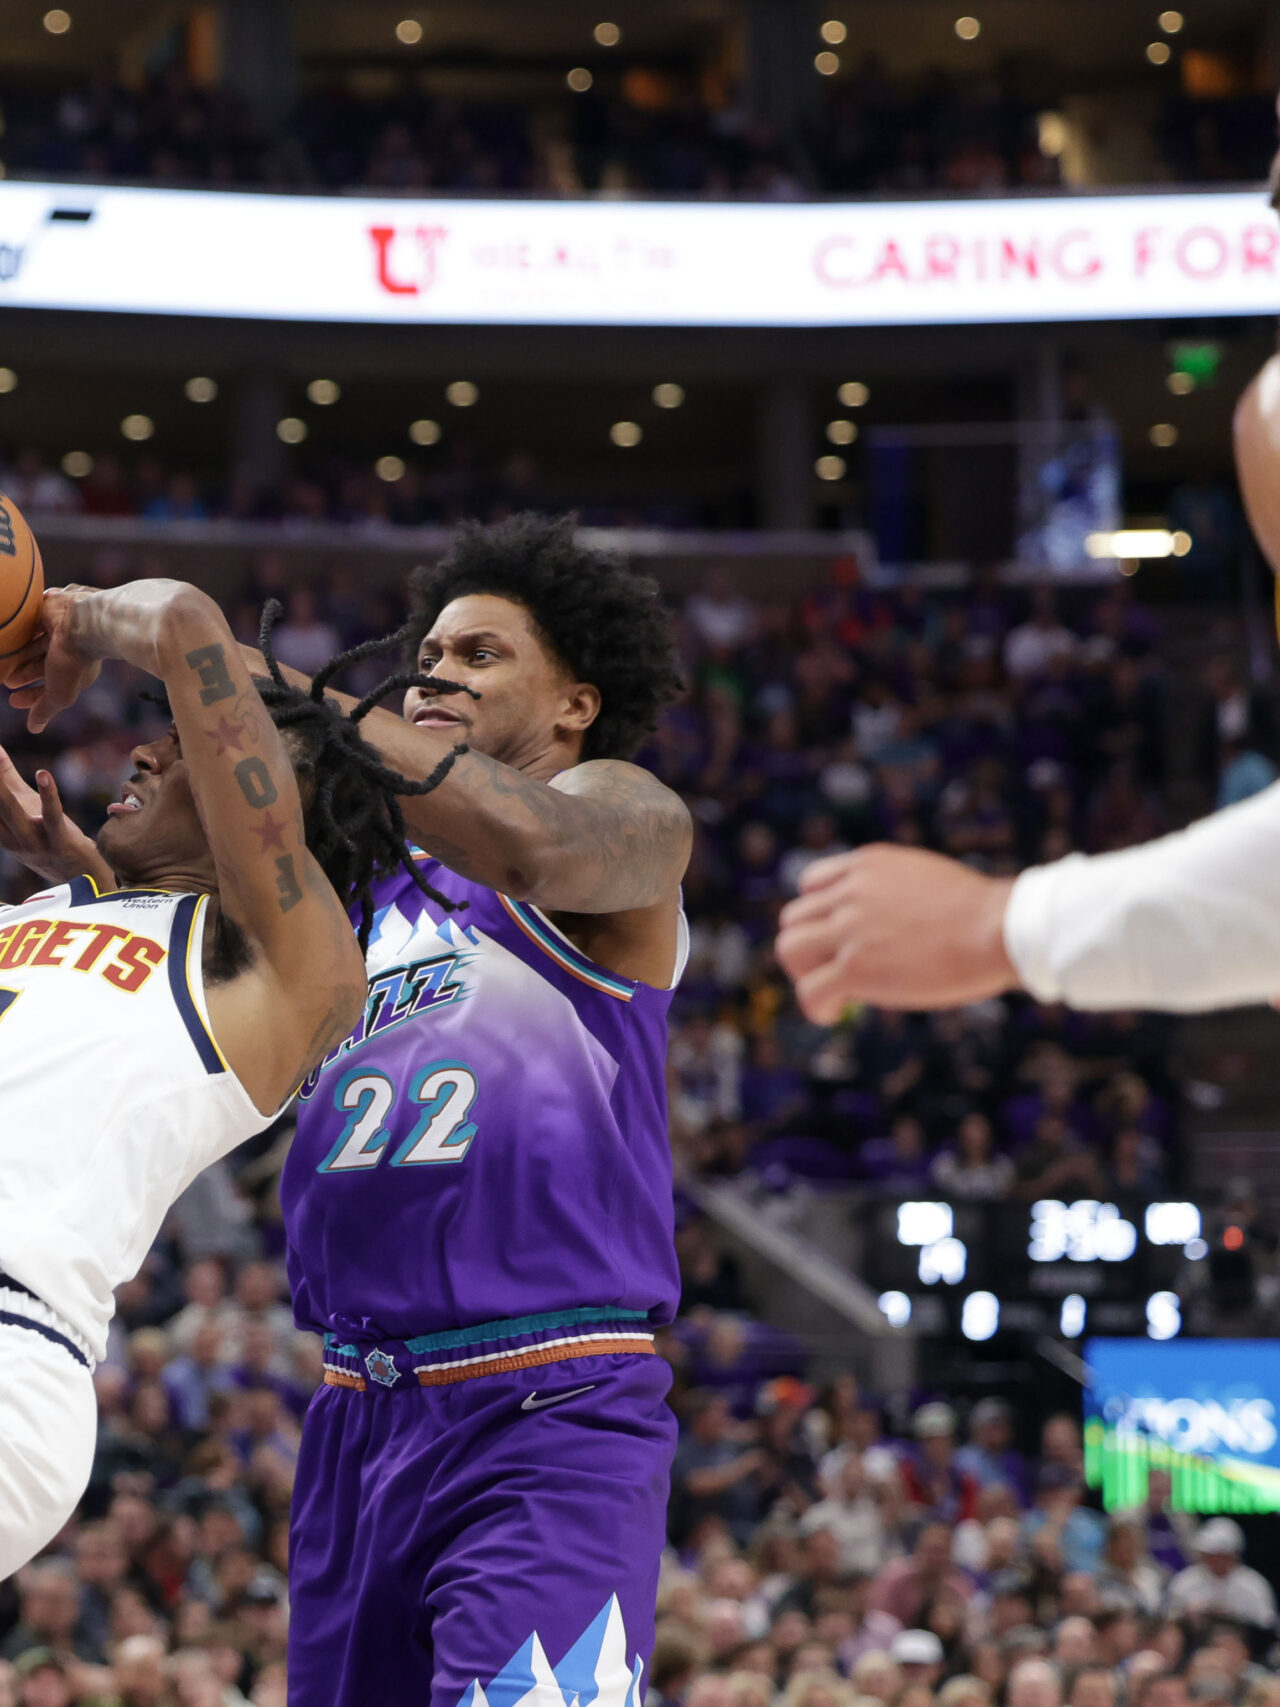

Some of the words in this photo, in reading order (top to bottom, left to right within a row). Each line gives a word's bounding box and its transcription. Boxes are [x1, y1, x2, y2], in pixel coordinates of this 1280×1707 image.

[811, 228, 1104, 289] CARING
[1131, 223, 1280, 280] FOR
[122, 902, 160, 910] Union
[316, 1059, 479, 1174] 22
